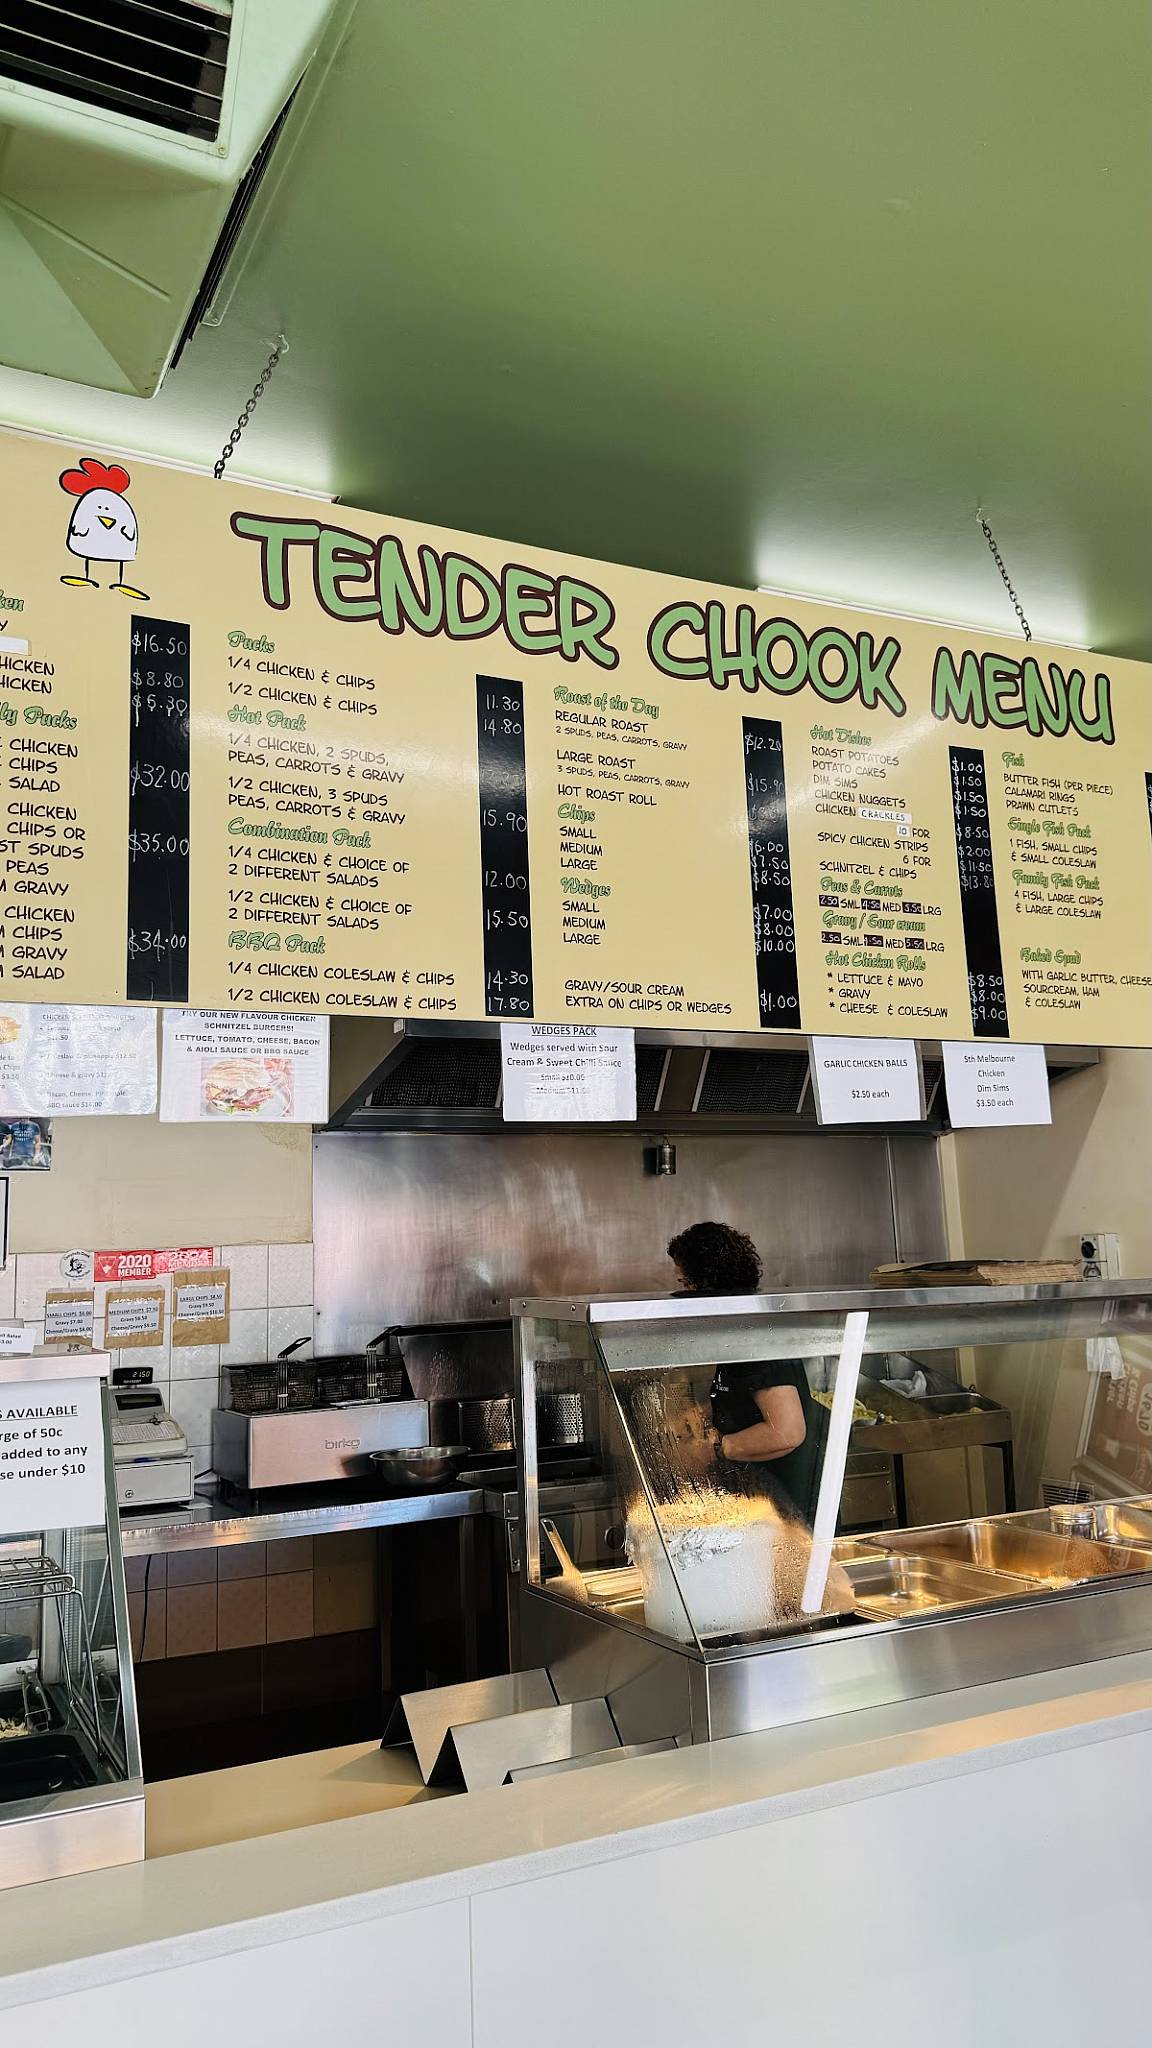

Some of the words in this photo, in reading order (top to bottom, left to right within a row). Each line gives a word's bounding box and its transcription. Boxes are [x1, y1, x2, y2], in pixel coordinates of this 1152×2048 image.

[230, 511, 620, 670] TENDER
[646, 600, 907, 718] CHOOK
[932, 645, 1116, 745] MENU
[131, 630, 187, 656] $16.50
[227, 631, 275, 654] Packs
[131, 668, 184, 690] $8.80
[228, 656, 251, 670] 1/4
[256, 661, 315, 680] CHICKEN
[321, 670, 330, 684] &
[336, 674, 375, 690] CHIPS
[486, 694, 521, 711] 11.30
[554, 685, 592, 705] Roast
[593, 693, 607, 712] of
[610, 695, 628, 711] the
[630, 698, 659, 719] Day
[24, 705, 77, 730] Packs
[227, 704, 262, 725] Hot
[266, 709, 306, 731] Pack
[555, 710, 607, 727] REGULAR
[611, 719, 648, 733] ROAST
[555, 726, 561, 734] 2
[663, 741, 687, 750] GRAVY
[810, 725, 834, 742] Hot
[835, 728, 872, 746] Dishes
[9, 737, 78, 757] CHICKEN
[812, 746, 844, 758] ROAST
[848, 751, 899, 766] POTATOES
[9, 757, 58, 773] CHIPS
[228, 750, 269, 767] PEAS,
[275, 757, 341, 775] CARROTS
[347, 765, 356, 778] &
[362, 768, 405, 783] GRAVY
[557, 749, 593, 764] LARGE
[598, 755, 636, 769] ROAST
[1002, 752, 1024, 768] Fish
[9, 776, 60, 792] SALAD
[130, 760, 190, 796] $32.00
[1003, 773, 1039, 786] BUTTER
[1042, 778, 1060, 788] FISH
[1064, 780, 1084, 791] (PER
[1087, 784, 1113, 795] PIECE)
[815, 790, 855, 802] CHICKEN
[859, 794, 906, 808] NUGGETS
[1005, 787, 1045, 799] CALAMARI
[1049, 792, 1075, 803] RINGS
[7, 802, 77, 821] CHICKEN
[558, 803, 595, 824] Chips
[815, 804, 856, 816] CHICKEN
[861, 809, 905, 821] CRACKLES
[7, 822, 56, 837] CHIPS
[63, 827, 86, 841] OR
[227, 817, 328, 844] Combination
[332, 828, 372, 848] Pack
[560, 826, 597, 839] SMALL
[912, 828, 930, 838] FOR
[28, 842, 84, 859] SPUDS
[128, 828, 190, 862] $35.00
[560, 842, 603, 856] MEDIUM
[958, 845, 990, 858] $2.00
[6, 860, 49, 875] PEAS
[228, 845, 252, 858] 1/4
[257, 849, 317, 865] CHICKEN
[324, 853, 332, 867] &
[339, 857, 388, 872] CHOICE
[393, 862, 410, 873] OF
[560, 857, 598, 870] LARGE
[228, 864, 238, 874] 2
[244, 865, 320, 883] DIFFERENT
[326, 872, 379, 887] SALADS
[819, 861, 874, 875] SCHNITZEL
[879, 867, 885, 876] &
[889, 868, 917, 879] CHIPS
[14, 881, 69, 896] GRAVY
[560, 876, 611, 899] Wedges
[820, 876, 848, 893] Peas
[850, 879, 861, 894] &
[864, 880, 903, 897] Carrots
[486, 908, 529, 930] 15.50
[754, 903, 793, 921] $7.00
[128, 928, 186, 962] $34.00
[228, 930, 281, 951] BBQ
[285, 934, 326, 954] Pack
[754, 938, 795, 955] $10.00
[825, 950, 849, 966] Hot
[852, 952, 894, 969] Chicken
[897, 955, 926, 972] Rolls
[228, 961, 252, 975] 1/4
[258, 963, 317, 978] CHICKEN
[323, 968, 396, 983] COLESLAW
[401, 970, 410, 983] &
[417, 972, 455, 986] CHIPS
[487, 970, 529, 991] 14.30
[1022, 970, 1043, 980] WITH
[1047, 972, 1077, 982] GARLIC
[565, 980, 642, 994] GRAVY/SOUR
[647, 985, 684, 997] CREAM
[1083, 986, 1099, 997] HAM
[487, 996, 530, 1012] 17.80
[760, 989, 797, 1012] $1.00
[175, 1035, 215, 1043] LETTUCE,
[532, 1026, 570, 1035] WEDGES
[573, 1027, 597, 1036] PACK
[510, 1042, 544, 1052] Wedges
[547, 1043, 575, 1052] served
[578, 1044, 596, 1052] with
[599, 1045, 618, 1053] Sour
[507, 1058, 534, 1066] Cream
[537, 1058, 543, 1066] &
[546, 1058, 573, 1067] Sweet
[824, 1060, 851, 1068] GARLIC
[852, 1059, 884, 1068] CHICKEN
[886, 1059, 908, 1067] BALLS
[977, 1055, 1015, 1063] Melbourne
[851, 1090, 870, 1099] $2.50
[872, 1090, 890, 1098] each
[977, 1084, 991, 1092] Dim
[992, 1084, 1009, 1092] Sims
[976, 1099, 995, 1108] $3.50
[997, 1099, 1013, 1107] each
[118, 1255, 151, 1268] 2020
[118, 1267, 151, 1277] MEMBER
[7, 1405, 78, 1419] AVAILABLE
[24, 1428, 36, 1439] of
[40, 1427, 63, 1438] 50c
[1, 1447, 42, 1460] added
[47, 1448, 60, 1457] to
[64, 1446, 87, 1457] any
[19, 1466, 58, 1478] under
[62, 1463, 86, 1476] $10
